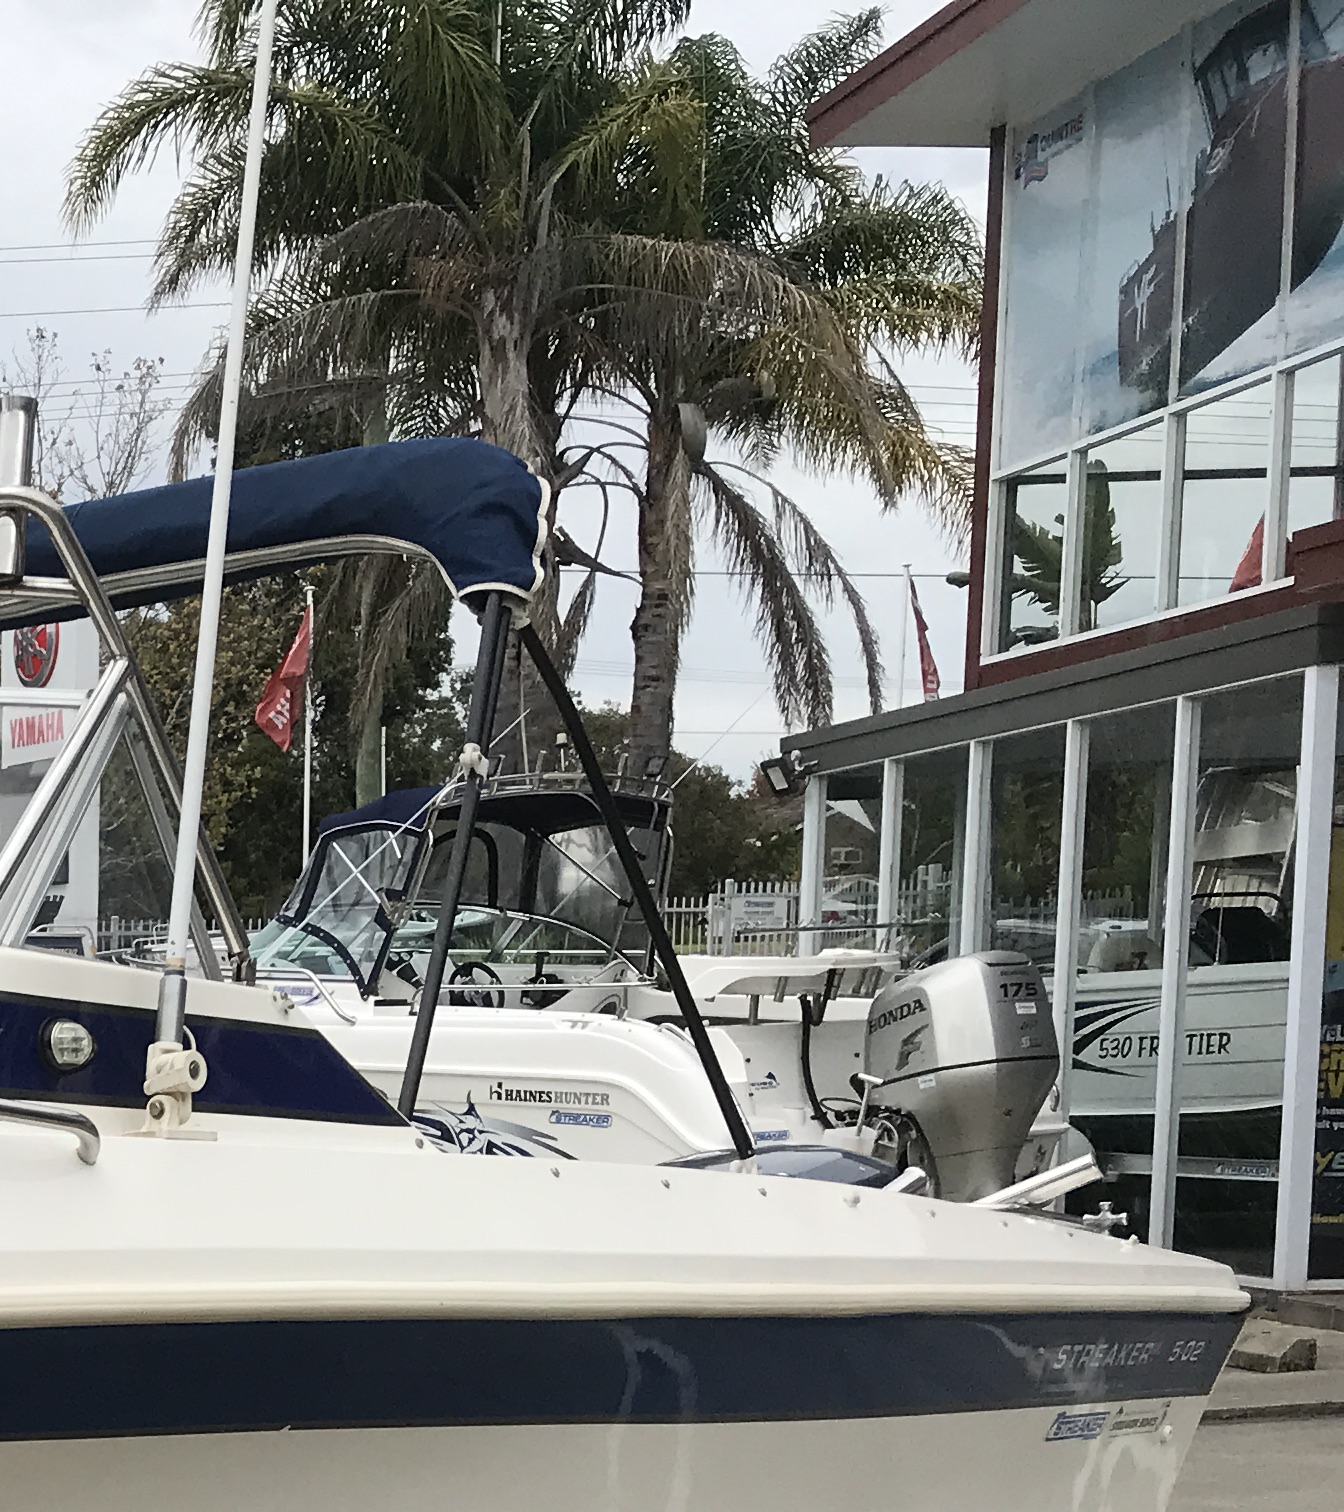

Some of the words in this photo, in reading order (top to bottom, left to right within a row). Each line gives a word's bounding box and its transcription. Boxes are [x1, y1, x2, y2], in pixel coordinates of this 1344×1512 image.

[9, 710, 64, 749] YAMAHA
[1000, 982, 1038, 998] 175
[868, 998, 928, 1035] HONDA
[1098, 1036, 1133, 1059] 530
[1137, 1032, 1231, 1059] FRTIER
[504, 1089, 552, 1103] HAINES
[553, 1091, 610, 1106] HUNTER
[1053, 1342, 1156, 1370] STREAKER
